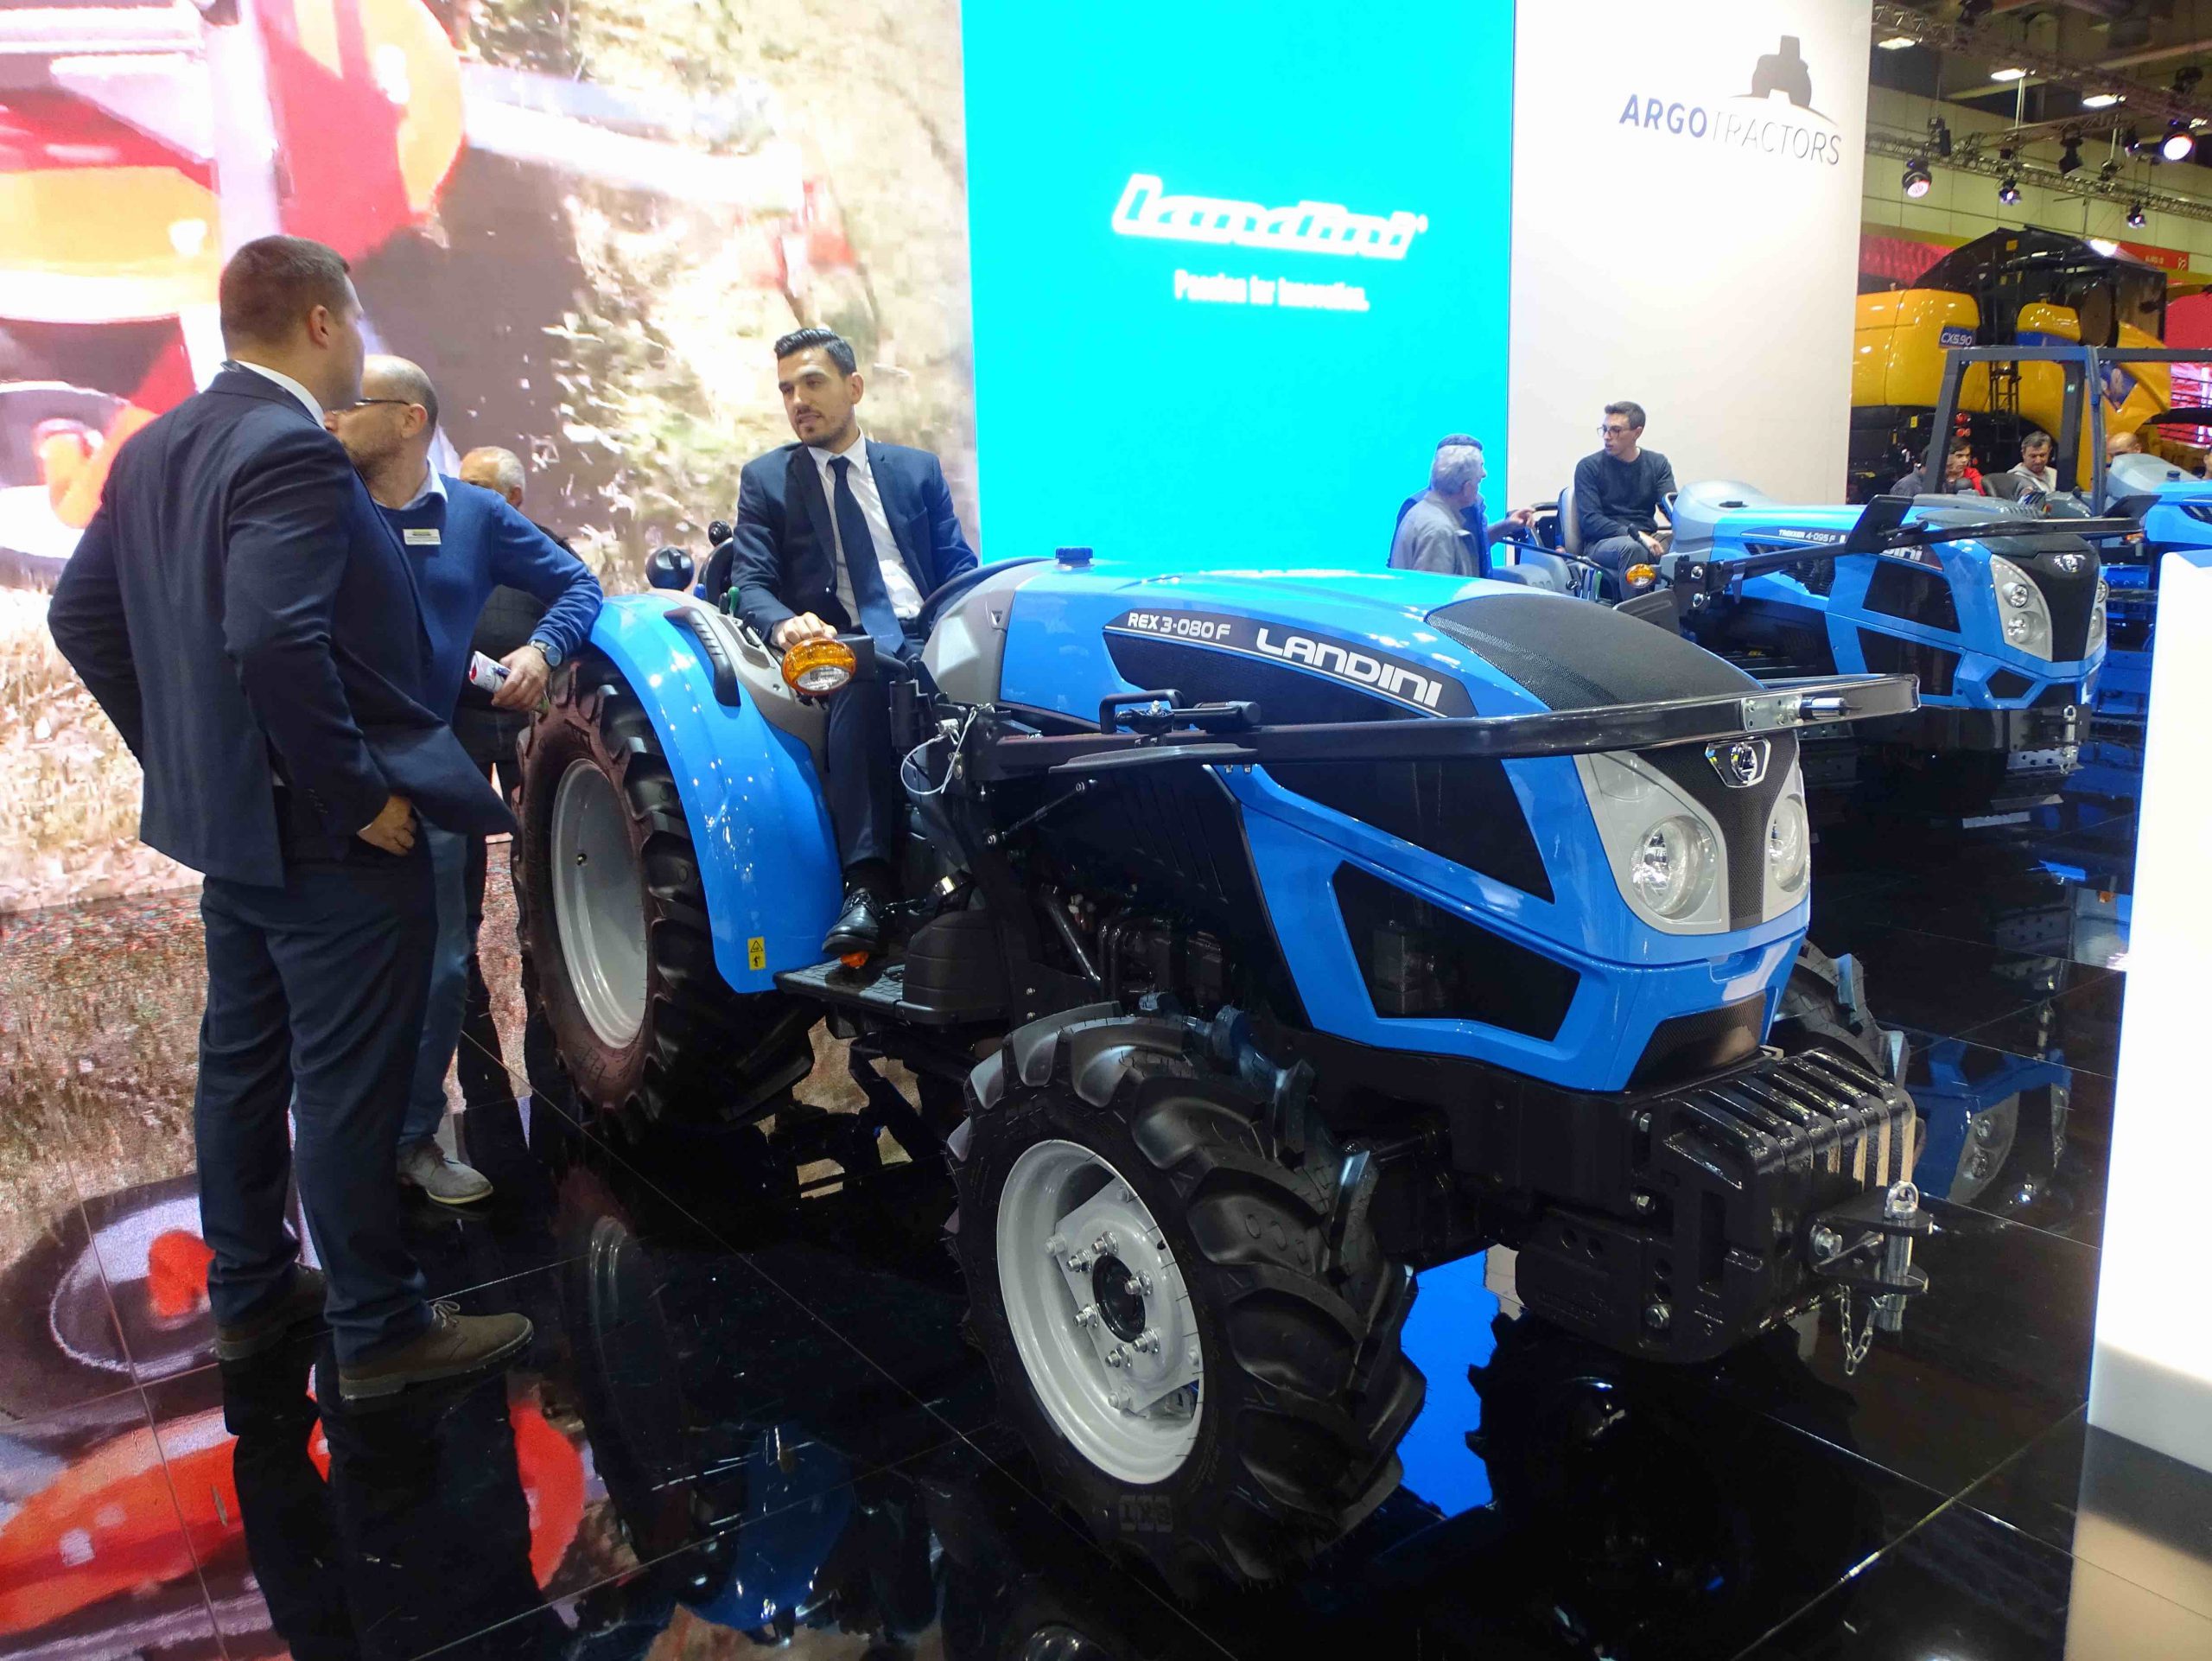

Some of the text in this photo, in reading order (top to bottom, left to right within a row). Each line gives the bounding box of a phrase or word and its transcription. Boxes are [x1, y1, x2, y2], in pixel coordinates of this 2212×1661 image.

[1128, 612, 1231, 640] REX 3-080 F
[1256, 627, 1443, 708] LANDINI
